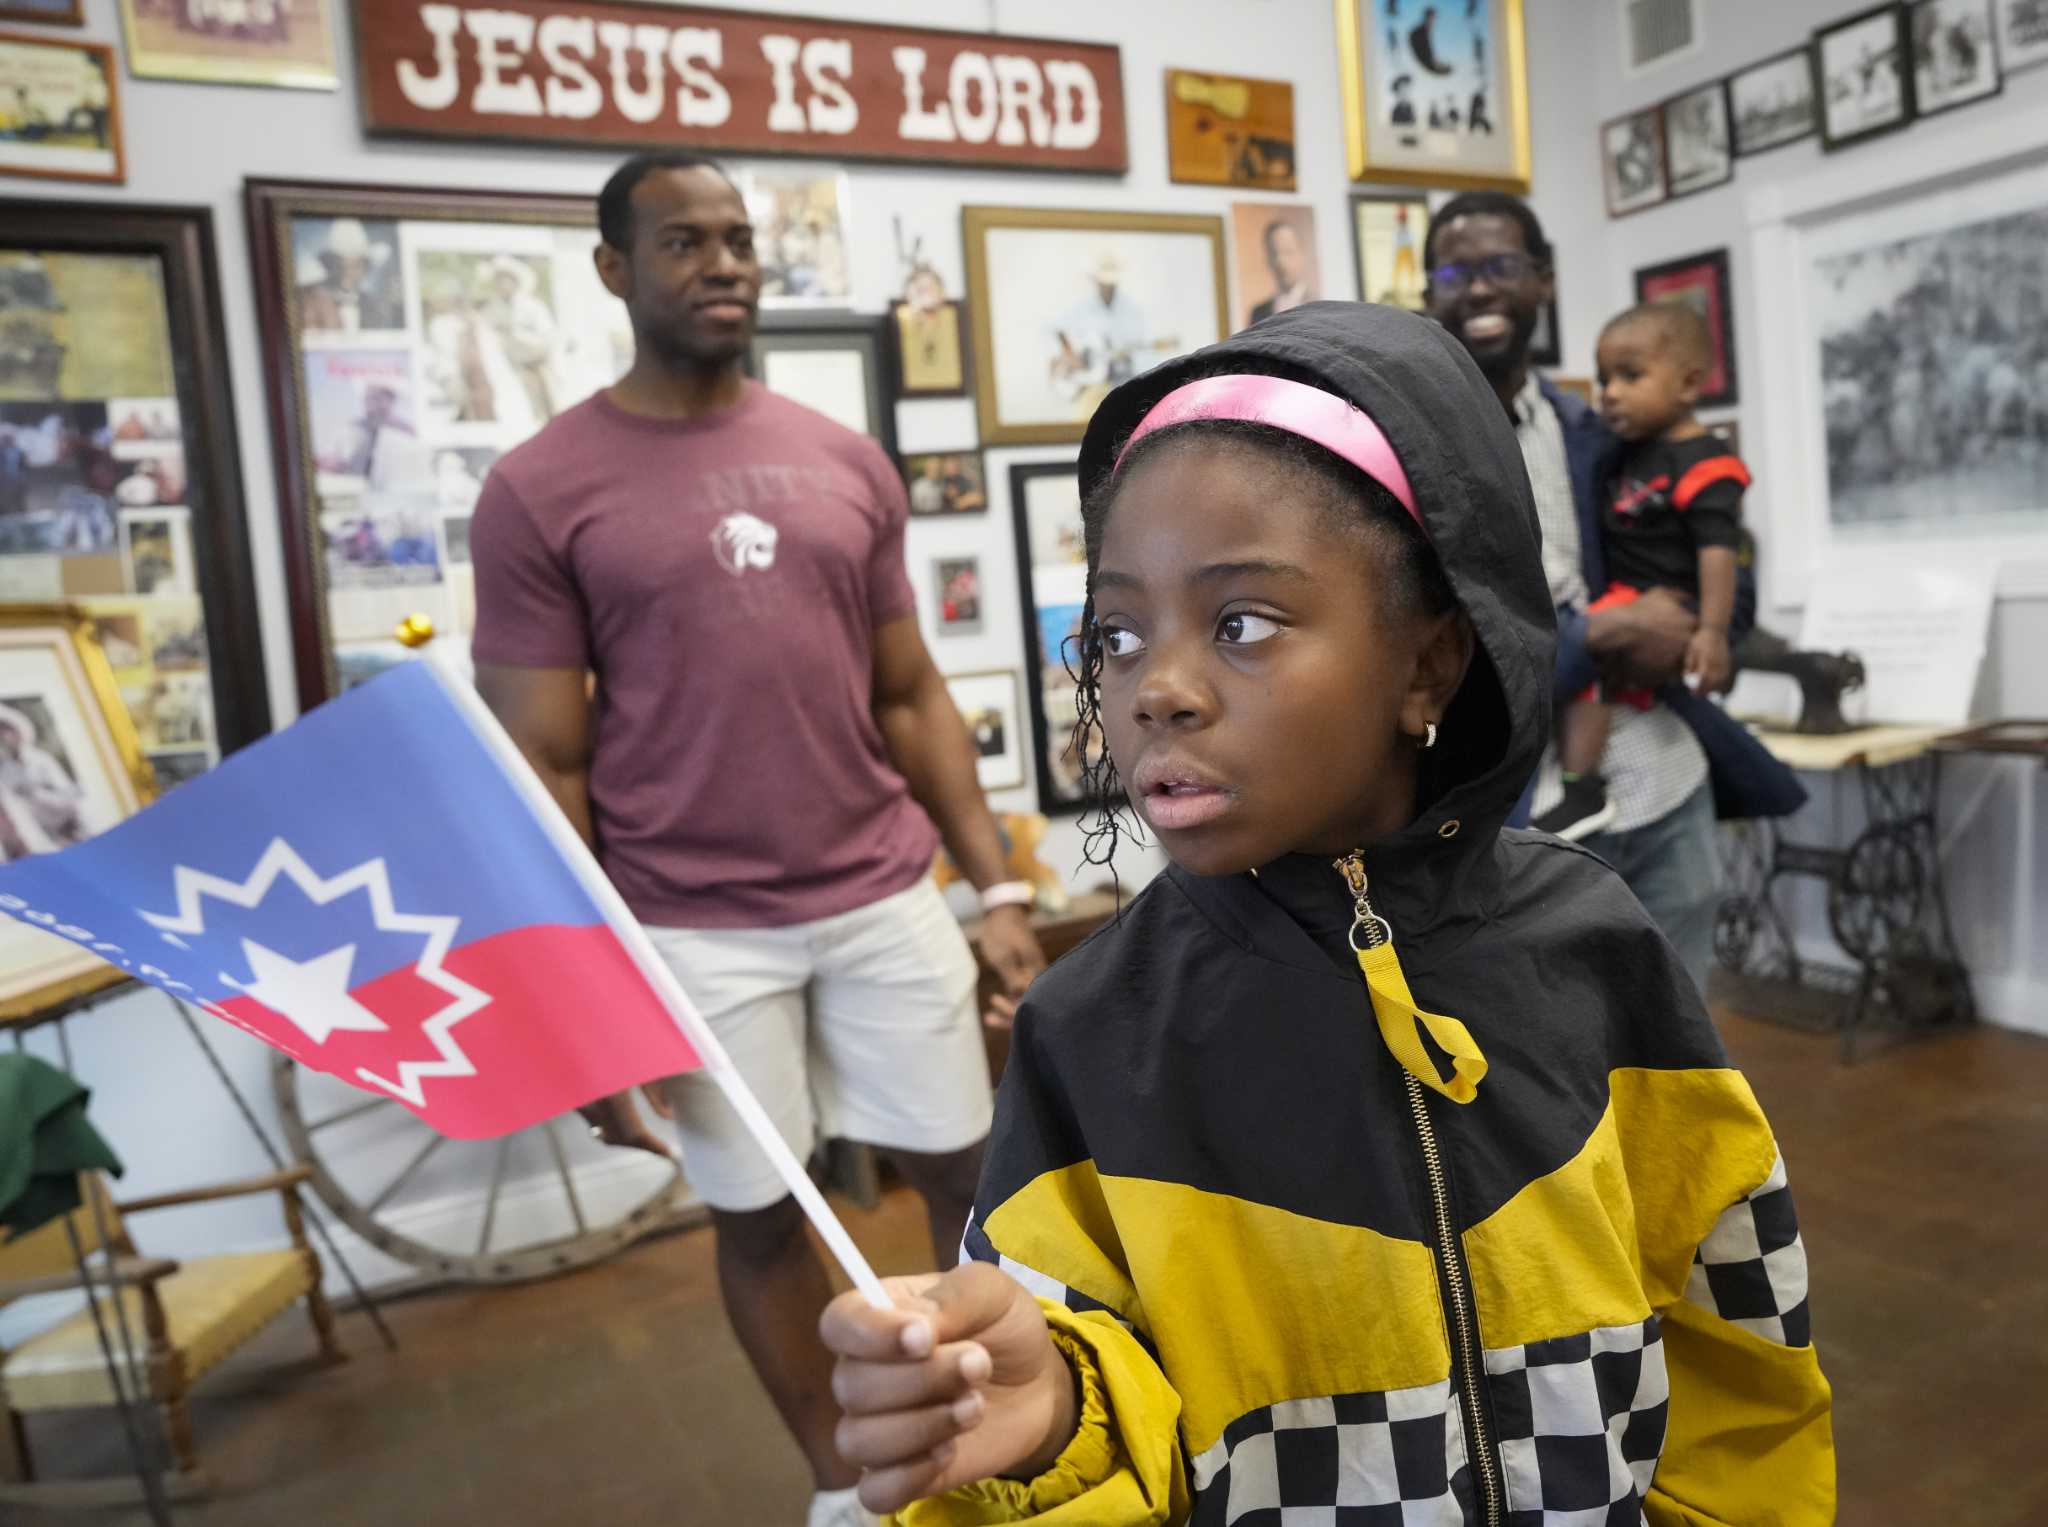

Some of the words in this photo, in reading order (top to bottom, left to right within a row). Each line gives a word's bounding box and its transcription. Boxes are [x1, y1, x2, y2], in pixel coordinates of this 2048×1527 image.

[396, 4, 732, 127] JESUS
[759, 34, 859, 134] IS
[892, 46, 1101, 149] LORD
